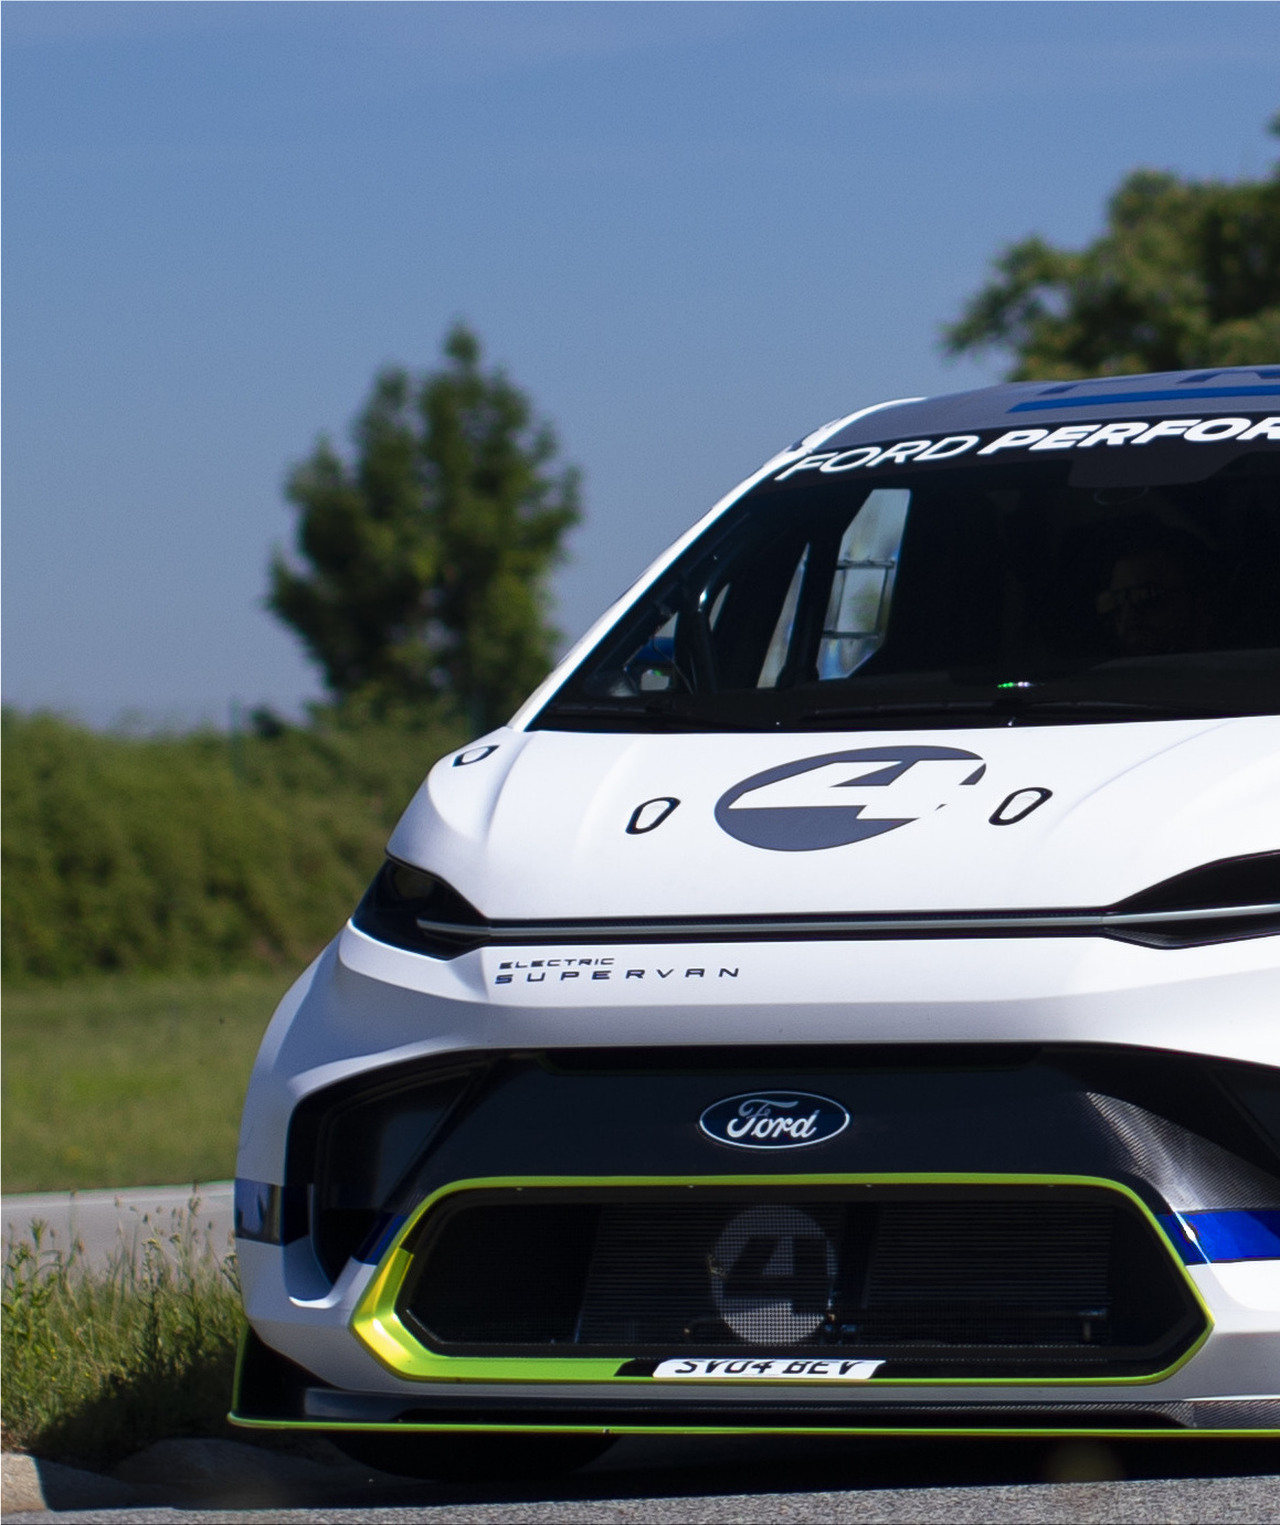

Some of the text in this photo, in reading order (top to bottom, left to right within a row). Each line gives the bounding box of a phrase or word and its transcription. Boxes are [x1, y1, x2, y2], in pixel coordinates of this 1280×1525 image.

[774, 435, 979, 481] FORD
[494, 968, 740, 985] SUPERVAN
[499, 958, 615, 970] ELECTRIC
[726, 1098, 818, 1138] Ford
